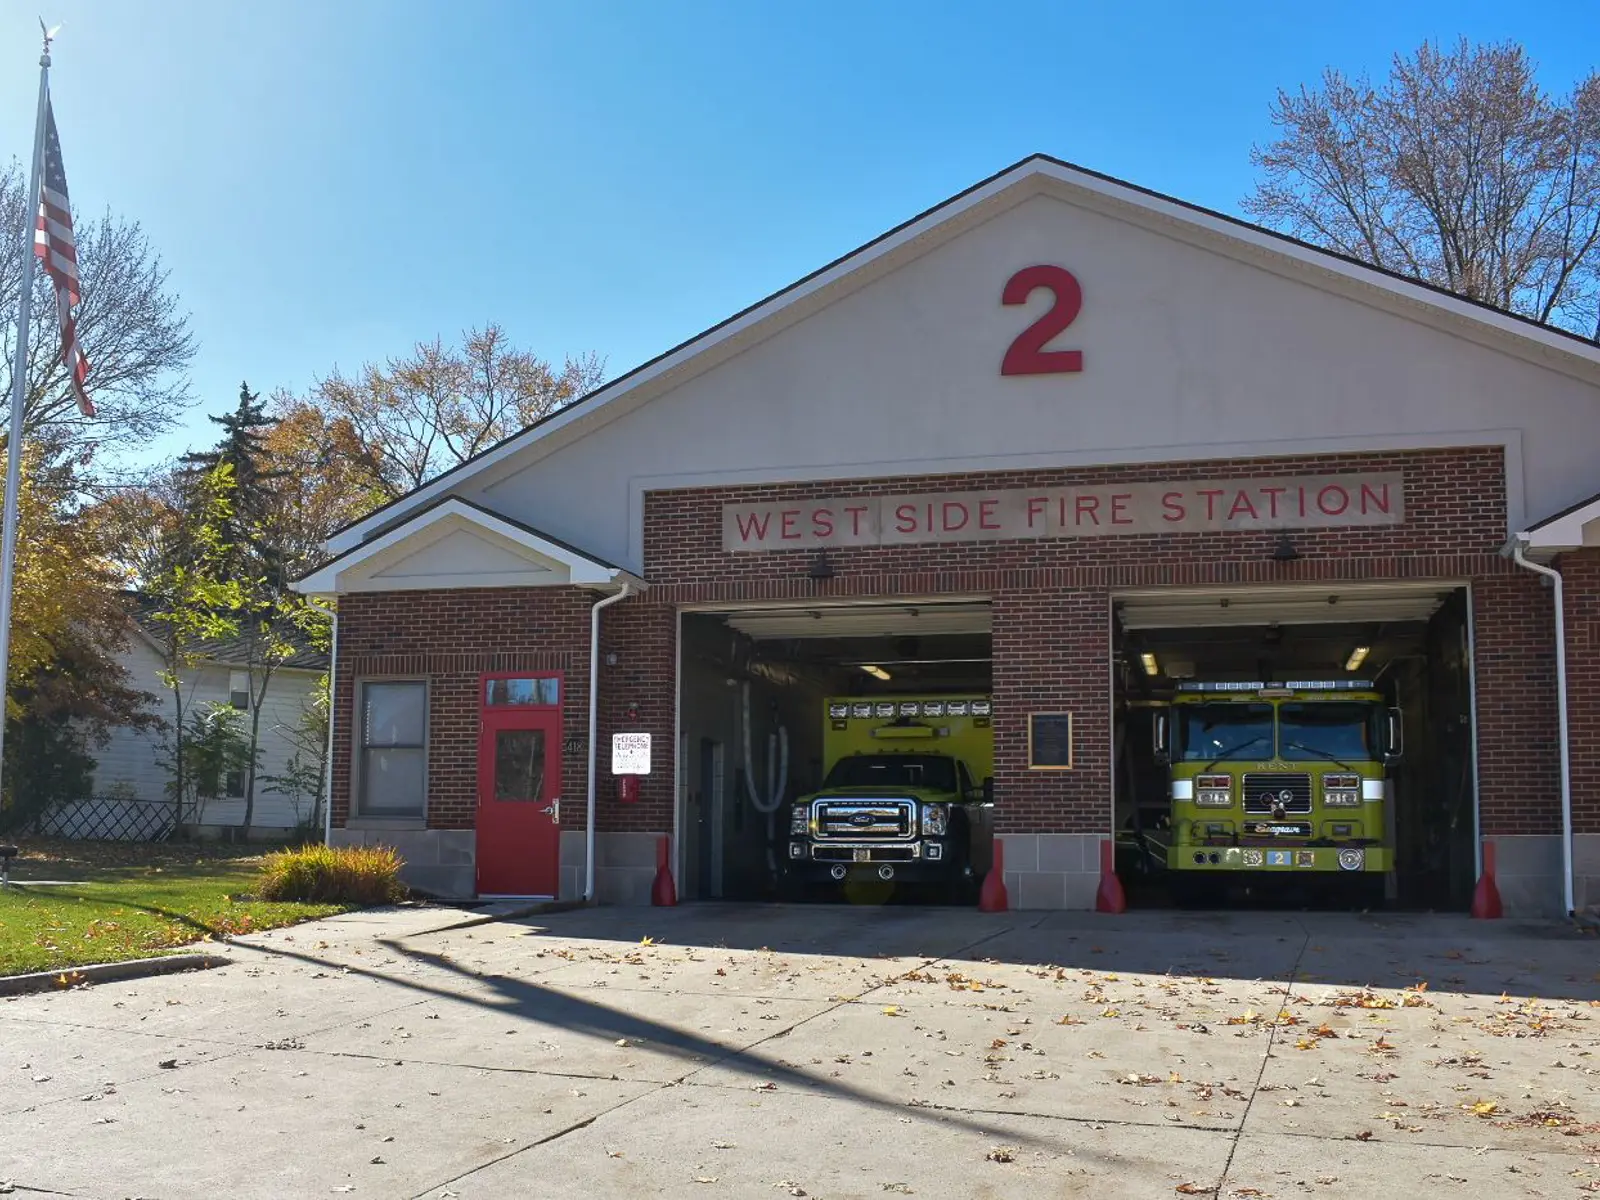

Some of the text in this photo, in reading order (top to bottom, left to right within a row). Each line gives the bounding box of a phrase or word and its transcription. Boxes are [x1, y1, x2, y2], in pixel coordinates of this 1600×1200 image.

[1001, 264, 1083, 376] 2
[735, 483, 1390, 542] WEST SIDE FIRE STATION
[1274, 852, 1285, 865] 2
